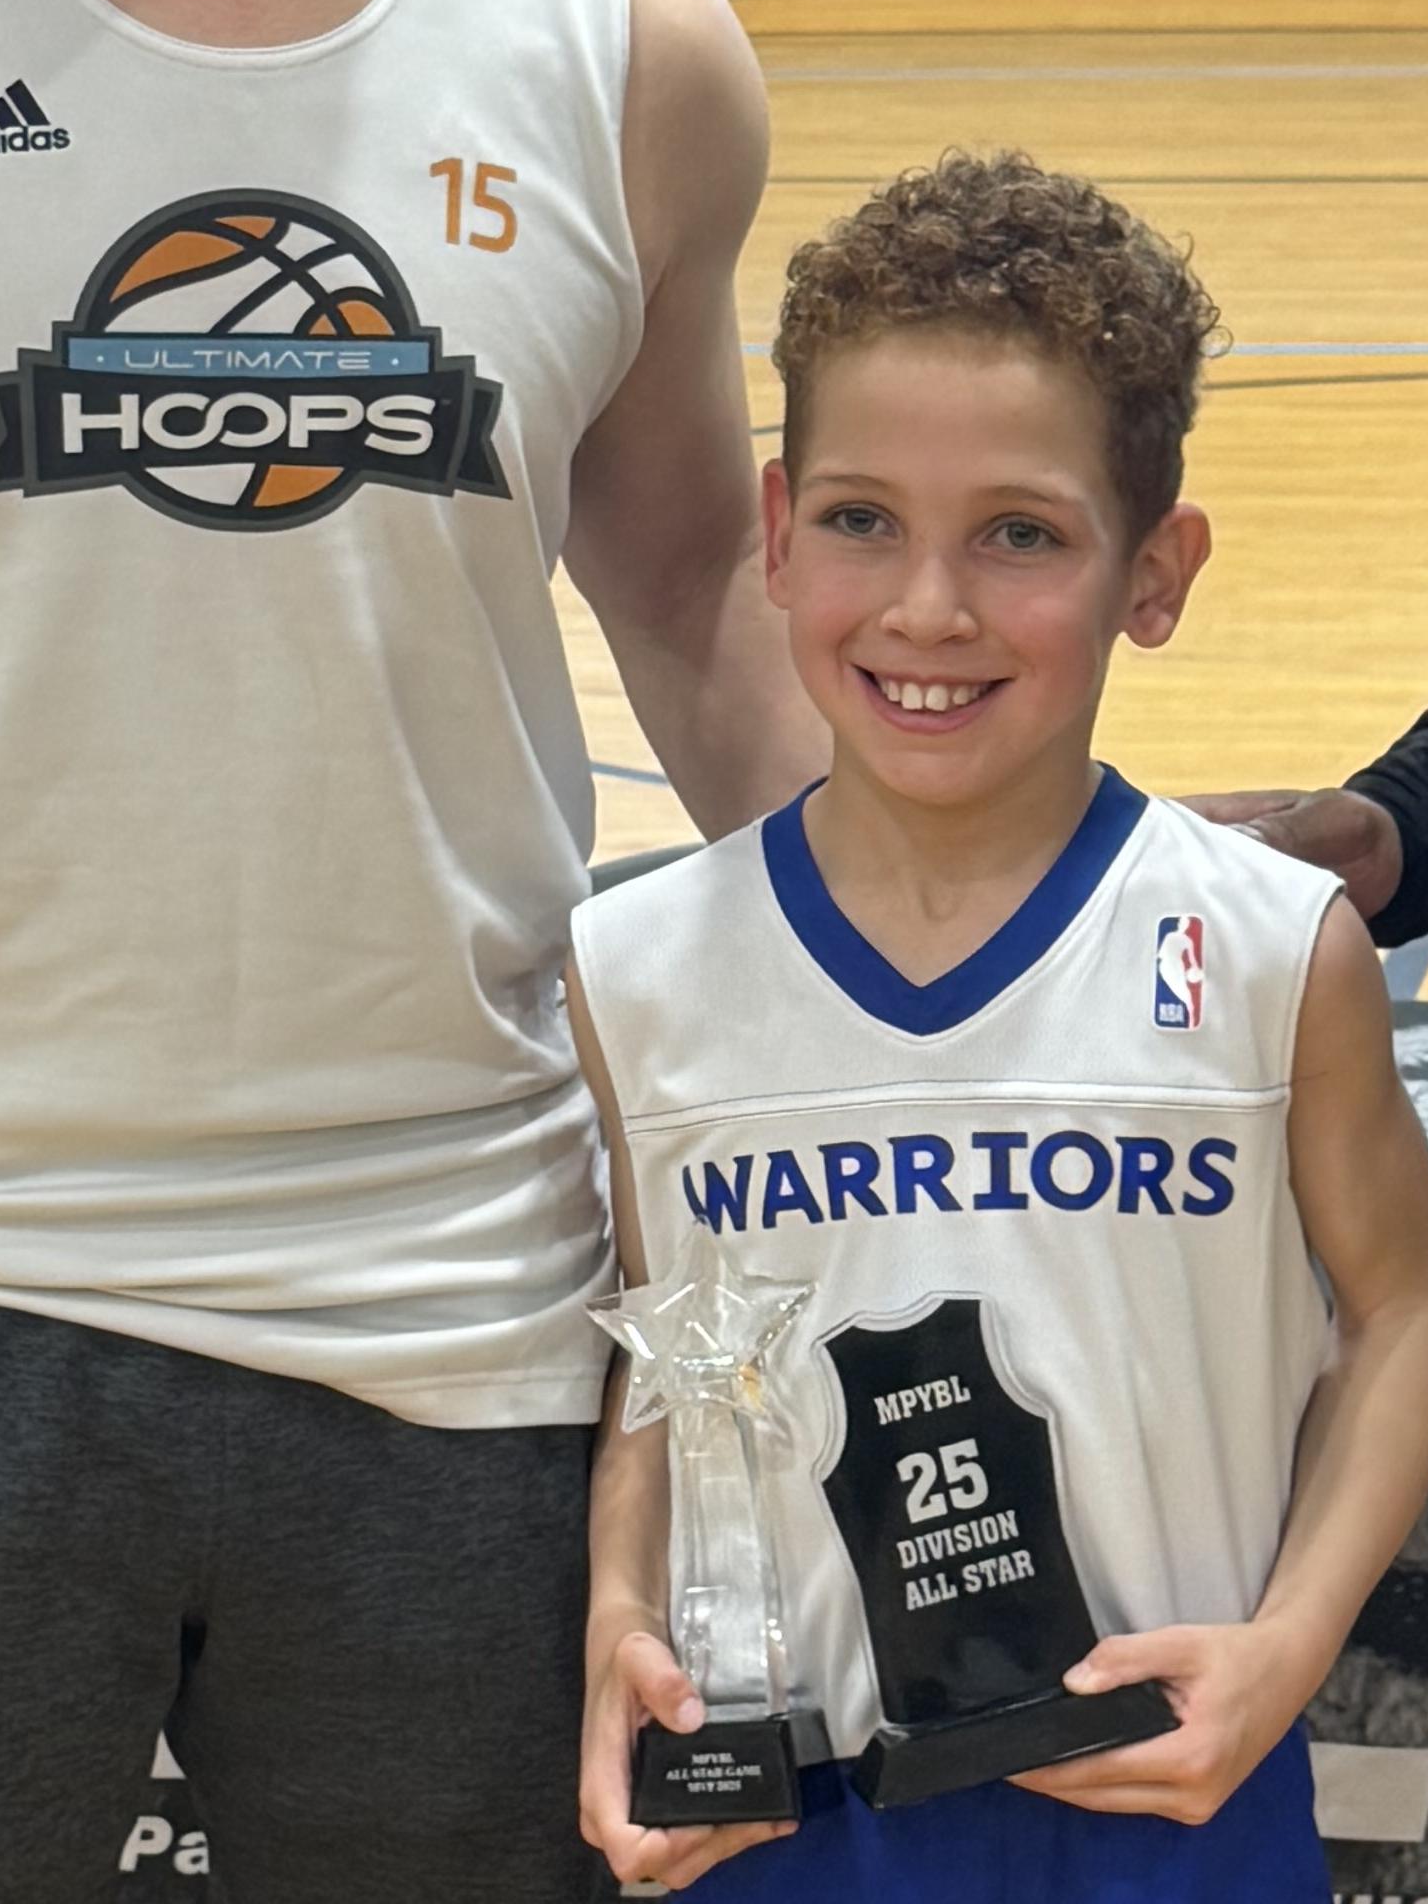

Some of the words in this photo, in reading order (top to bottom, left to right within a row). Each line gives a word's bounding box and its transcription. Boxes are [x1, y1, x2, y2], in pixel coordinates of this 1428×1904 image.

[429, 157, 518, 254] 15
[123, 349, 373, 372] ULTIMATE
[61, 391, 436, 456] HOOPS
[681, 1130, 1238, 1236] WARRIORS
[874, 1375, 972, 1426] MPYBL
[895, 1437, 989, 1525] 25
[896, 1509, 1020, 1570] DIVISION
[905, 1572, 959, 1612] ALL
[961, 1549, 1036, 1594] STAR
[119, 1815, 210, 1875] Pa
